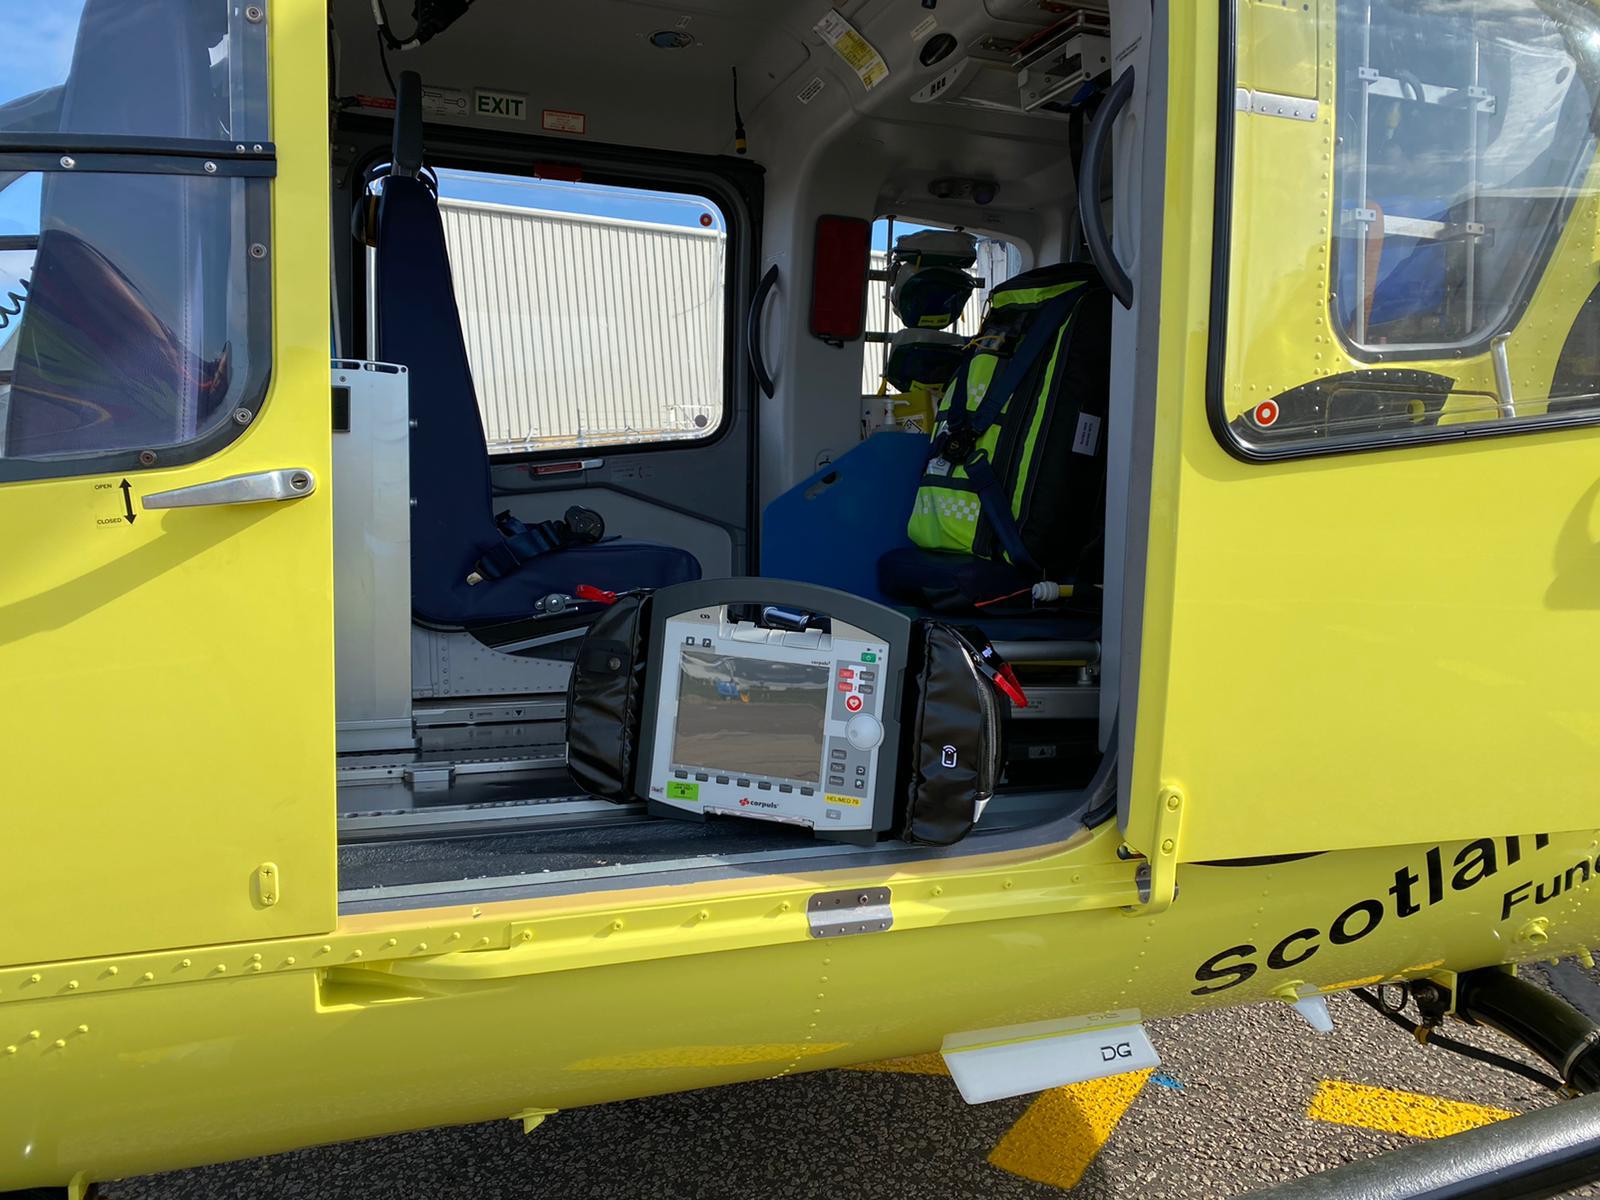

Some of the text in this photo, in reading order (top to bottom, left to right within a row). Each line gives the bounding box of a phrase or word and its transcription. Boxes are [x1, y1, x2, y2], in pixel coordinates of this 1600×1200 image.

[478, 95, 524, 116] EXIT
[97, 517, 122, 525] CLOSED
[750, 800, 778, 809] corpuls
[1101, 1042, 1132, 1061] DG
